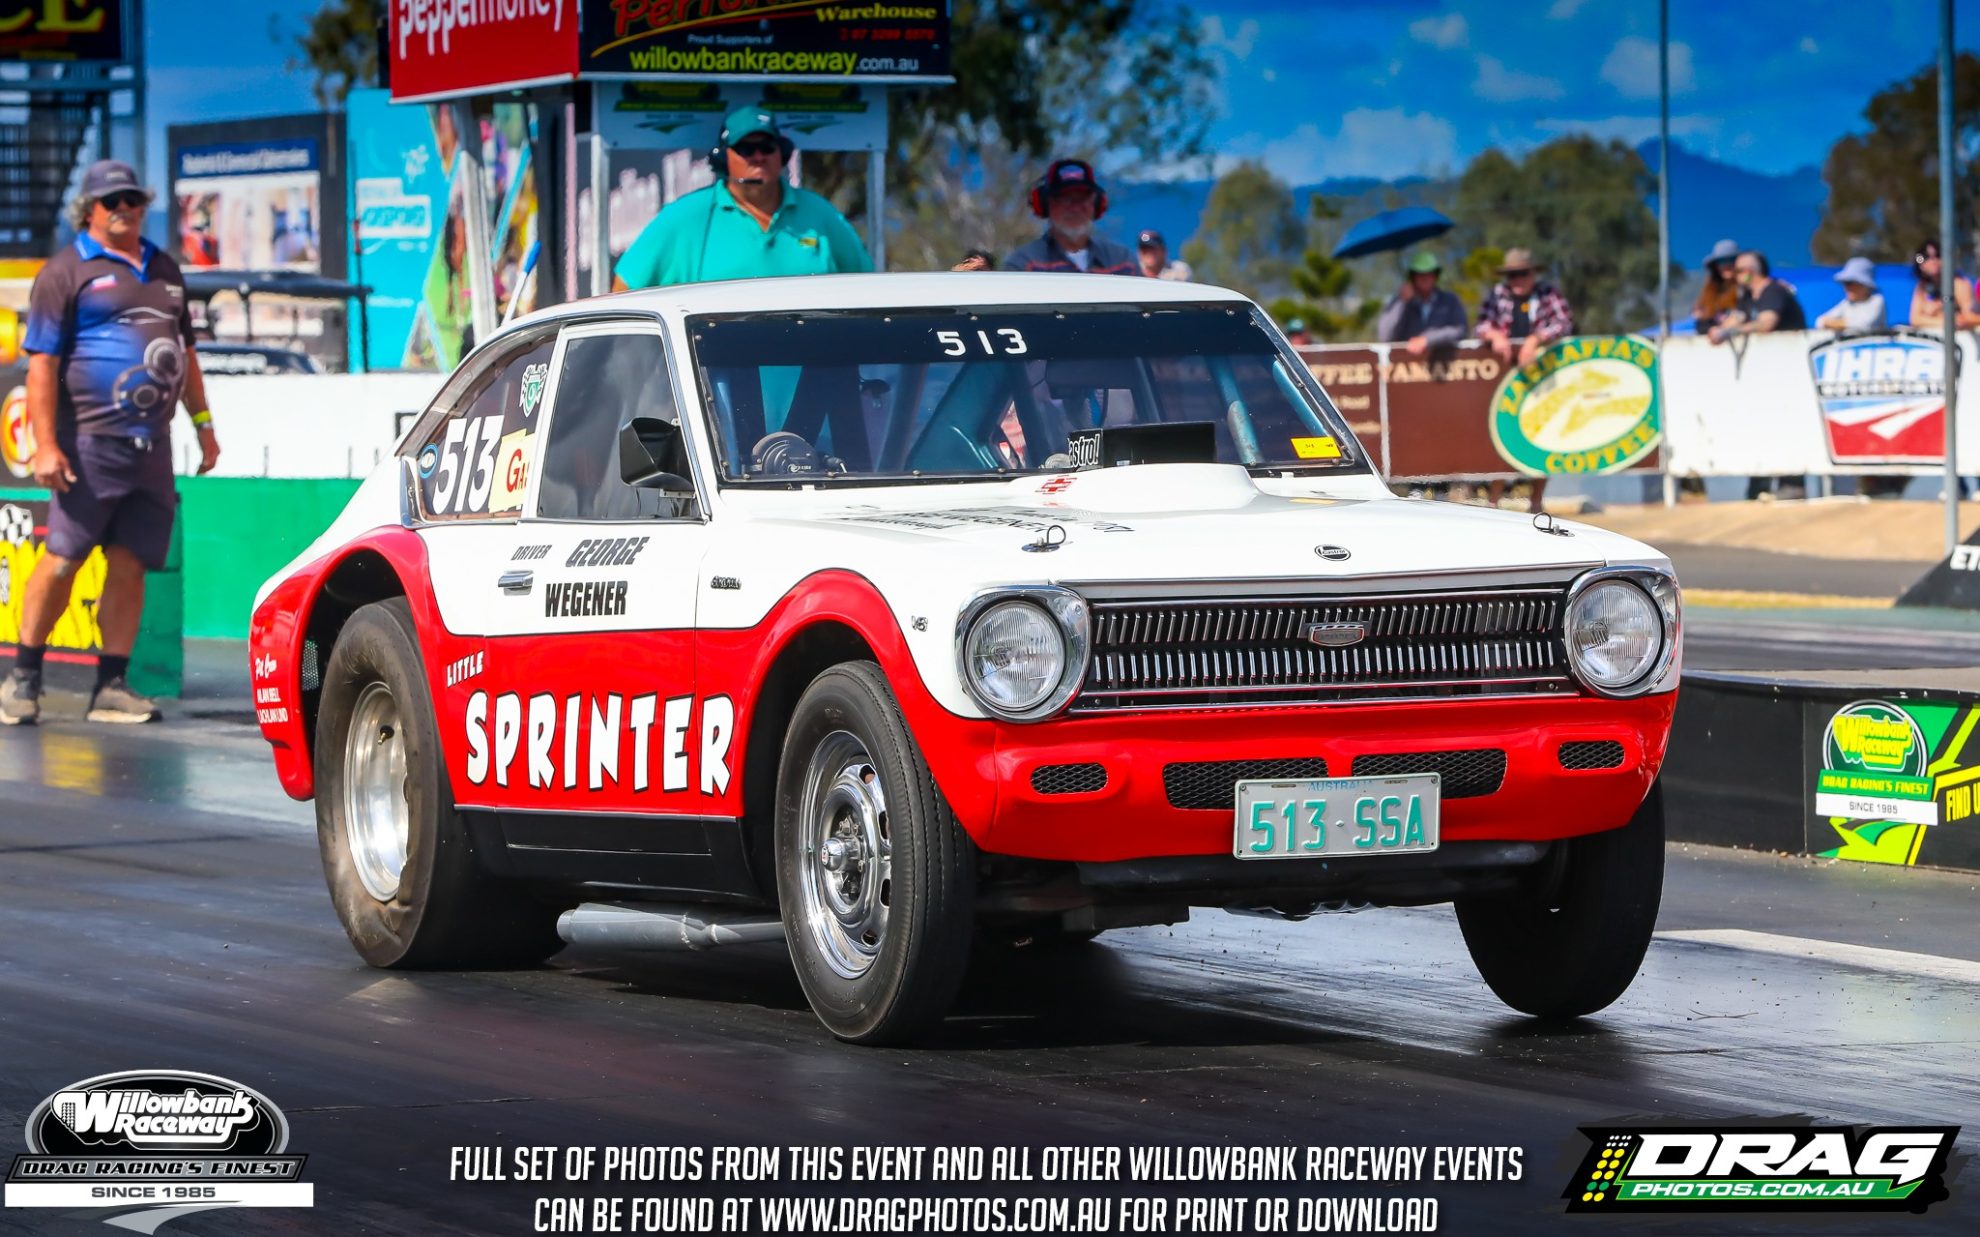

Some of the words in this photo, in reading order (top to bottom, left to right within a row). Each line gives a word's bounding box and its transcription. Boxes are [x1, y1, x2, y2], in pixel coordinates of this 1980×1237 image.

[815, 3, 937, 22] Warehouse
[937, 328, 1028, 356] 513
[1817, 347, 1946, 383] IHRA
[432, 415, 505, 515] 513
[1545, 420, 1656, 474] COFFEE
[511, 545, 552, 560] DRIVER
[565, 536, 650, 568] GEORGE
[545, 580, 628, 617] WEGENER
[446, 650, 484, 688] LITTLE
[465, 689, 735, 798] SPRINTER
[1894, 781, 1929, 795] FINEST
[1946, 785, 1971, 822] FIND
[1250, 800, 1327, 852] 513
[1353, 795, 1425, 848] SSA
[1849, 801, 1875, 813] SINCE
[1877, 804, 1898, 815] 1985
